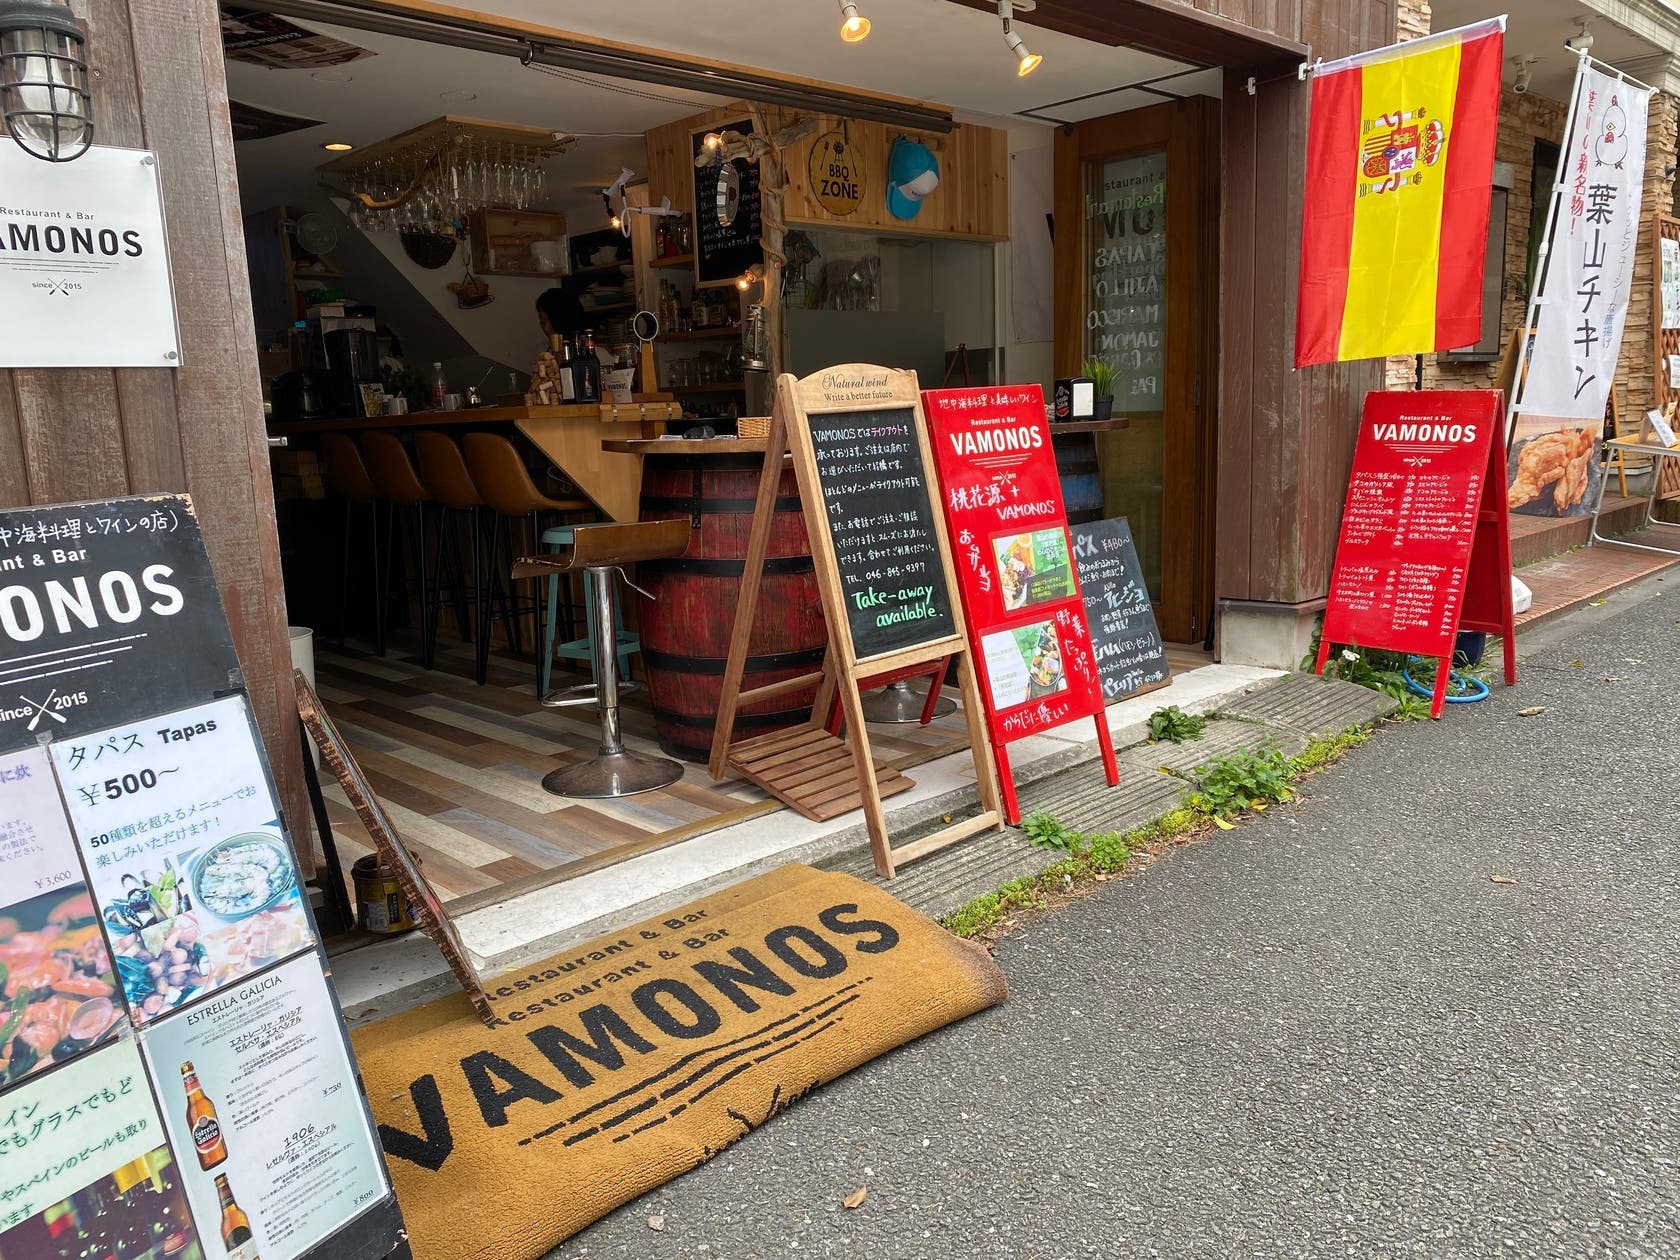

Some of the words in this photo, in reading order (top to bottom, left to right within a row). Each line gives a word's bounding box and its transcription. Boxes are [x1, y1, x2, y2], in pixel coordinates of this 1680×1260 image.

[829, 163, 849, 181] BBQ
[821, 179, 859, 200] ZONE
[66, 212, 72, 220] &
[77, 212, 95, 221] Bar
[0, 223, 143, 258] MONOS
[32, 281, 53, 289] since
[64, 283, 82, 291] 2015
[1574, 183, 1618, 400] 葉山チキン
[822, 374, 865, 389] Natural
[866, 375, 888, 387] wind
[824, 392, 844, 401] Write
[851, 391, 871, 400] better
[872, 390, 892, 399] future
[971, 418, 1000, 426] Restaurant
[1006, 416, 1017, 424] Bar
[950, 425, 1042, 456] VAMONOS
[1373, 423, 1477, 443] VAMONOS
[950, 483, 1006, 513] 桃花源
[996, 500, 1055, 520] VAMONOS
[33, 554, 45, 567] &
[52, 548, 87, 564] Bar
[846, 574, 862, 584] TEL.
[851, 586, 933, 610] Take-away
[876, 602, 943, 627] available.
[53, 691, 88, 710] 2015
[69, 733, 145, 770] タパス
[157, 719, 217, 744] Tapas
[657, 949, 680, 961] &
[682, 925, 731, 950] Bar
[486, 938, 634, 1002] estaurant
[639, 929, 661, 940] &
[663, 908, 709, 930] Bar
[187, 997, 239, 1026] ESTRELLA
[240, 976, 283, 1000] GALICIA
[377, 903, 900, 1173] VAMONOS
